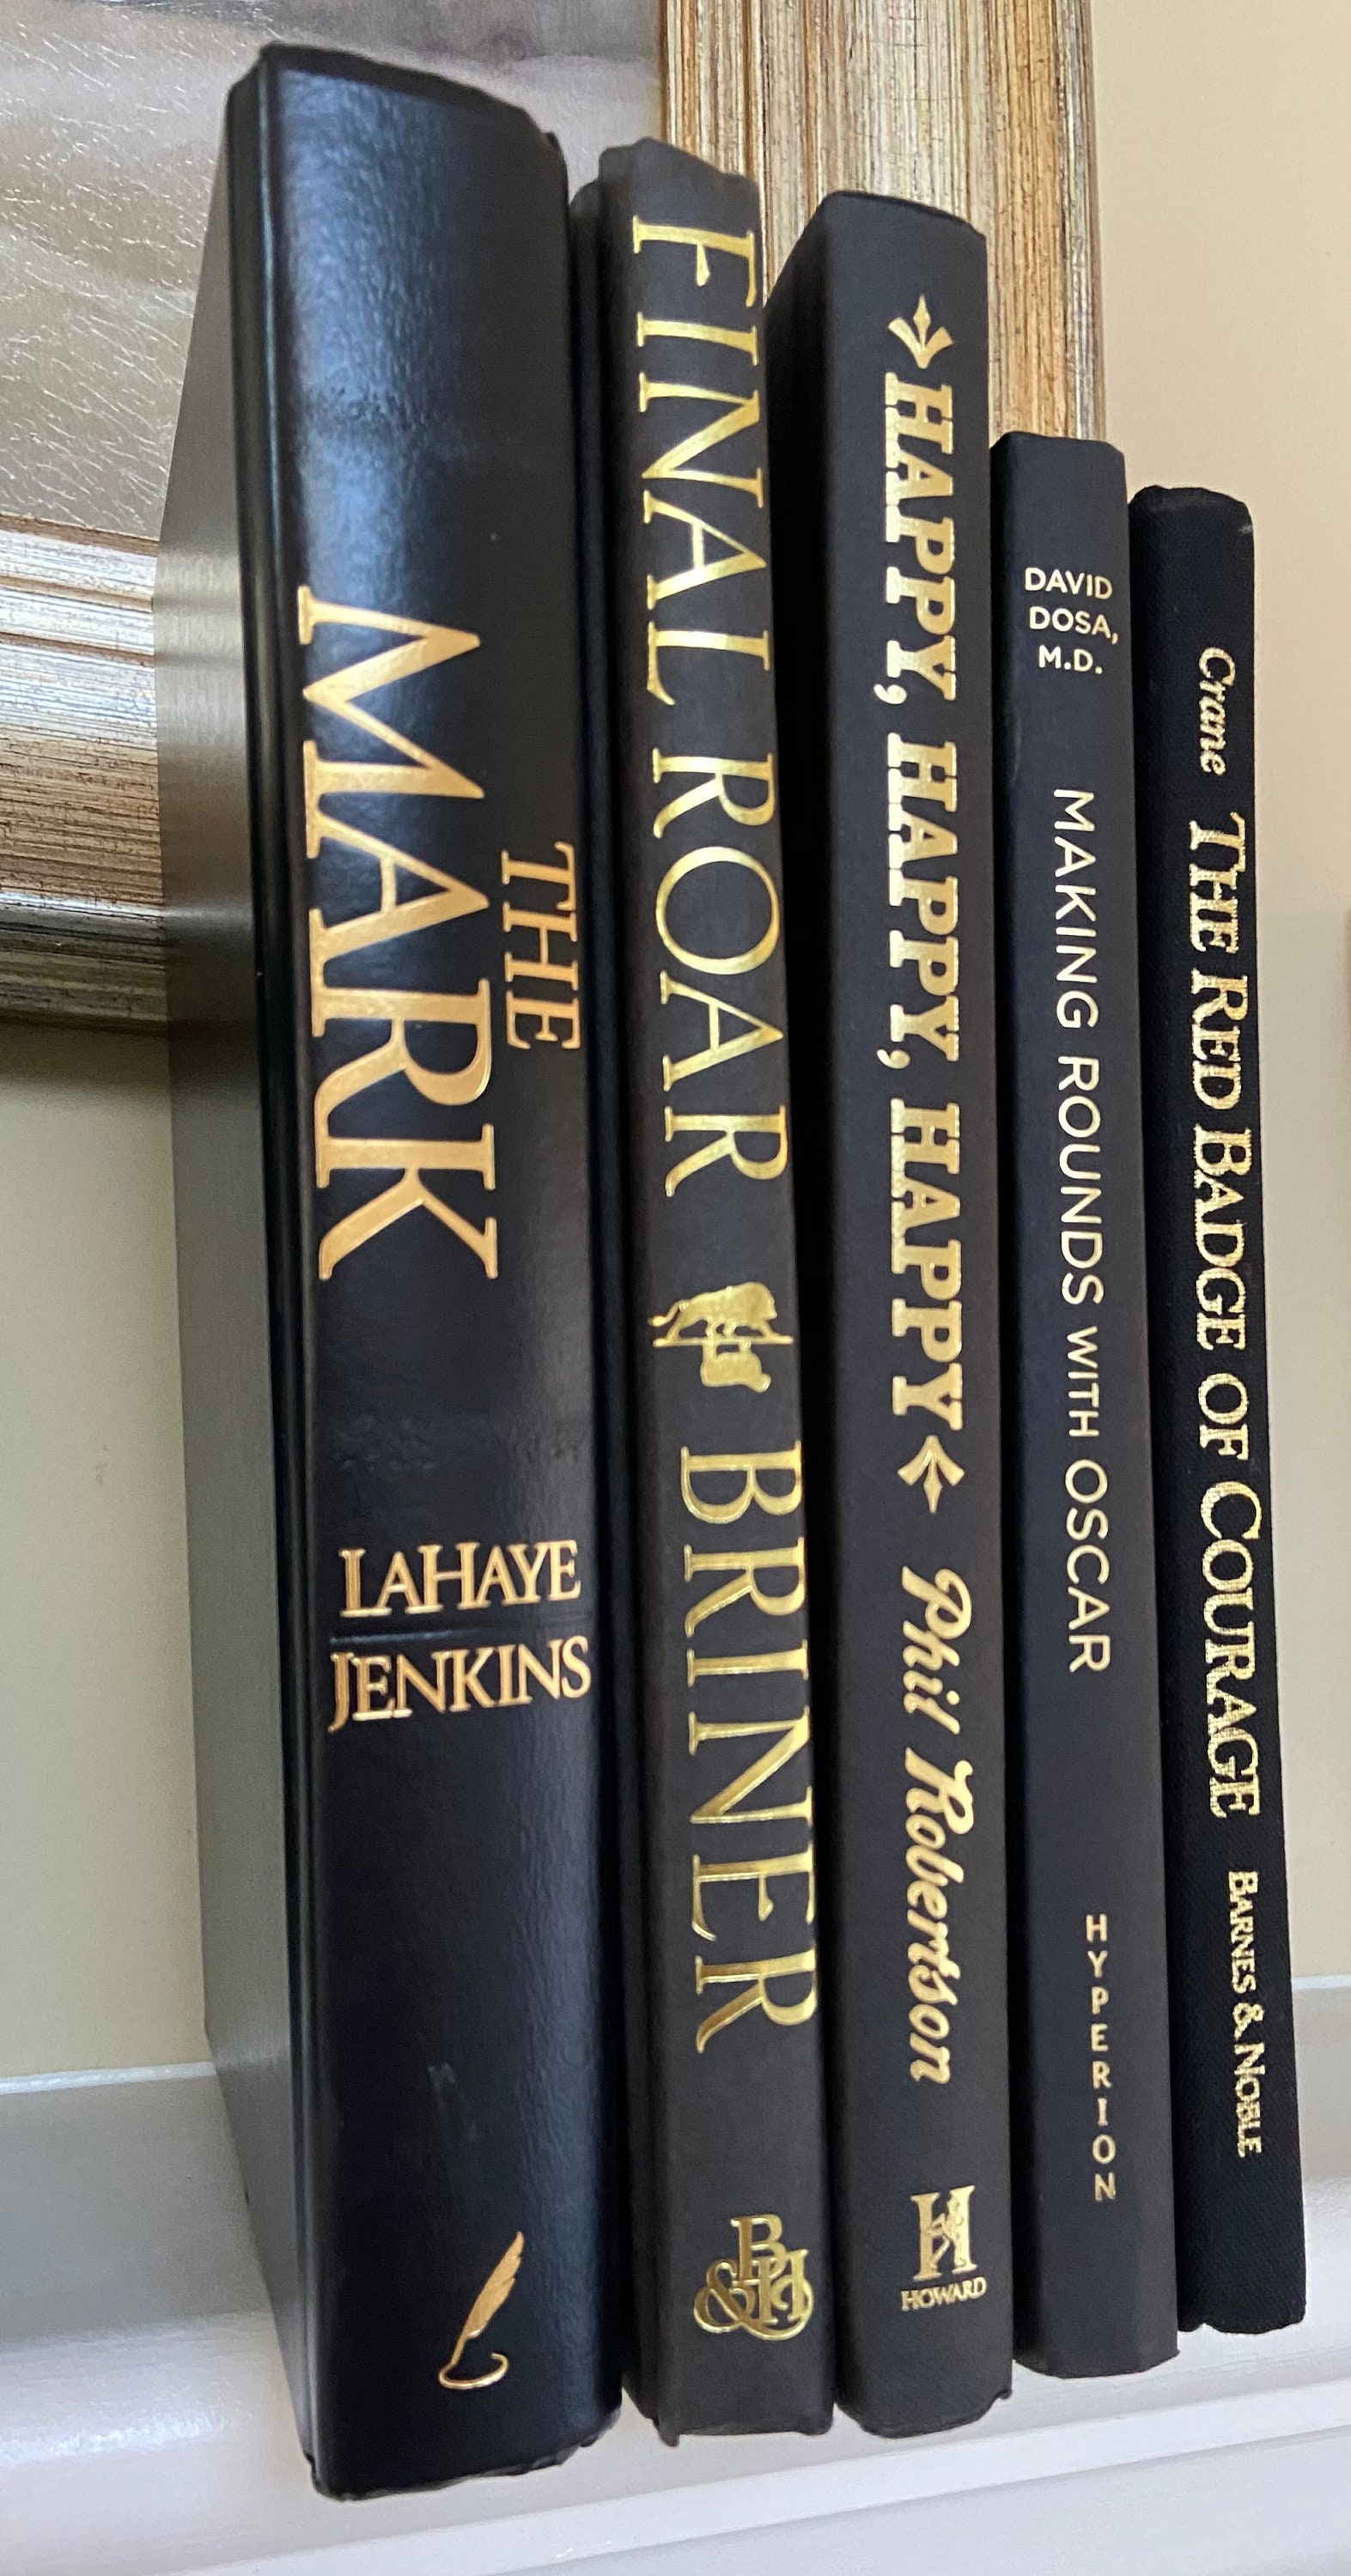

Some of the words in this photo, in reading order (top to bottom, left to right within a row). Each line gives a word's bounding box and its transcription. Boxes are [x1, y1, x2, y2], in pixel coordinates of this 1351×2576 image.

[633, 215, 771, 706] FINAL
[873, 371, 956, 705] HAPPY,
[1025, 567, 1113, 599] DAVID
[1029, 605, 1119, 645] DOSA,
[1038, 644, 1103, 674] M.D.
[1199, 647, 1235, 775] Crane
[297, 585, 498, 1281] MARK
[502, 841, 582, 1051] THE
[652, 747, 788, 1197] ROAR
[876, 732, 959, 1070] HAPPY,
[1053, 788, 1099, 1030] MAKING
[1189, 811, 1245, 953] THE
[1190, 968, 1249, 1110] RED
[890, 1097, 963, 1431] HAPPY
[1057, 1055, 1104, 1305] ROUNDS
[1194, 1122, 1252, 1352] BADGE
[1067, 1325, 1099, 1437] WITH
[1198, 1371, 1249, 1461] OF
[338, 1540, 581, 1618] LAHAYE
[902, 1565, 972, 1735] Phil
[1065, 1459, 1111, 1673] OSCAR
[1200, 1479, 1262, 1820] COURAGE
[327, 1635, 592, 1733] JENKINS
[680, 1439, 818, 2055] BRINER
[905, 1747, 974, 2085] Robertson
[1228, 1870, 1259, 1995] BARNES
[1086, 1912, 1117, 2202] HYPERION
[1232, 2002, 1265, 2040] &
[1234, 2041, 1266, 2159] NOBLE
[901, 2276, 989, 2312] HOWARD
